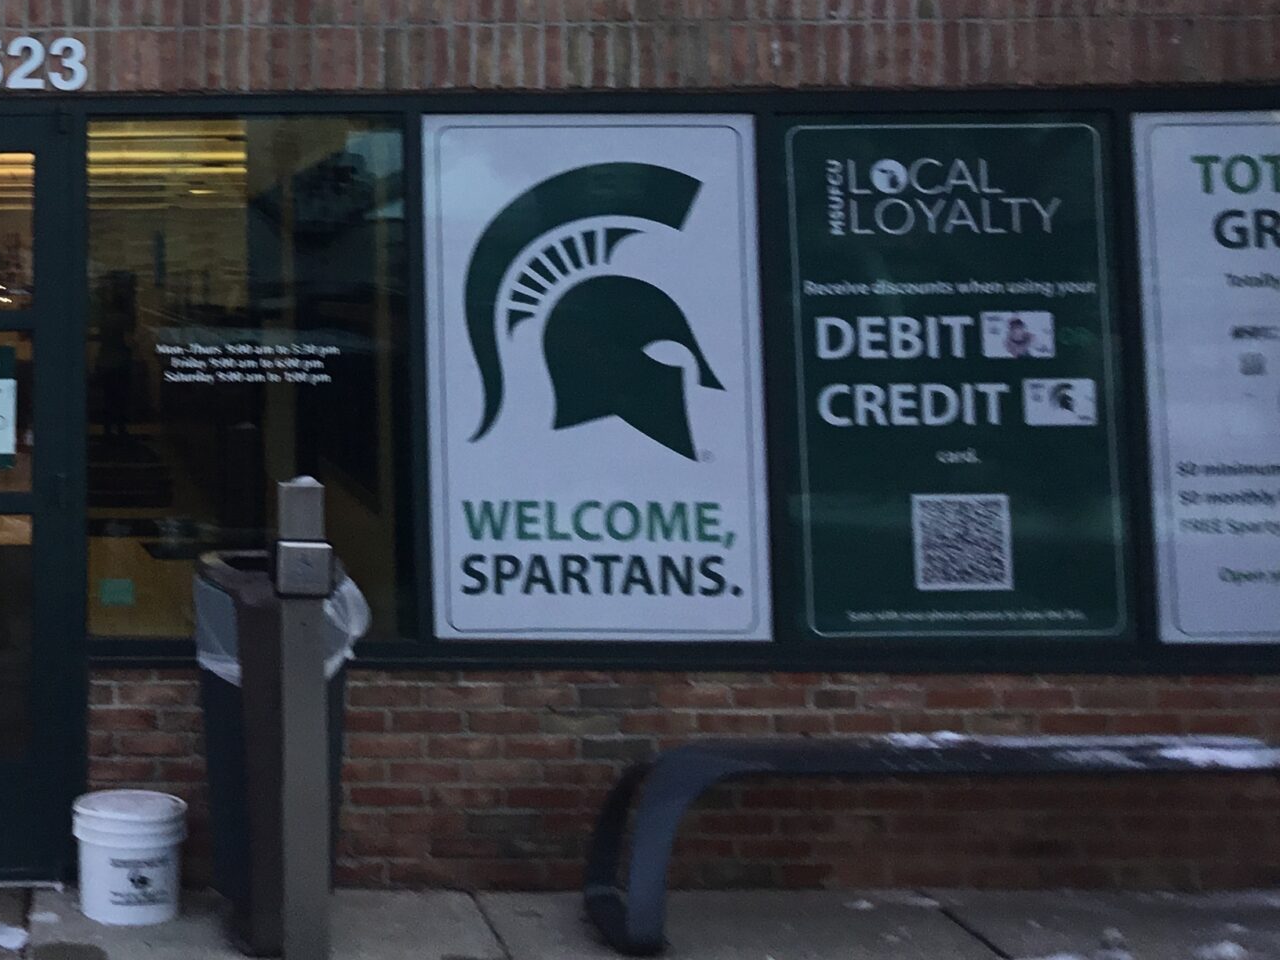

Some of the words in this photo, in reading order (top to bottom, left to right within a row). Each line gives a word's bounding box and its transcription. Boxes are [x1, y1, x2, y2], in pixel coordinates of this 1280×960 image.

[847, 158, 1006, 195] LOCAL
[849, 197, 1062, 236] LOYALTY
[815, 315, 974, 359] DEBIT
[817, 382, 1011, 427] CREDIT
[461, 499, 736, 550] WELCOME,
[460, 553, 744, 598] SPARTANS.
